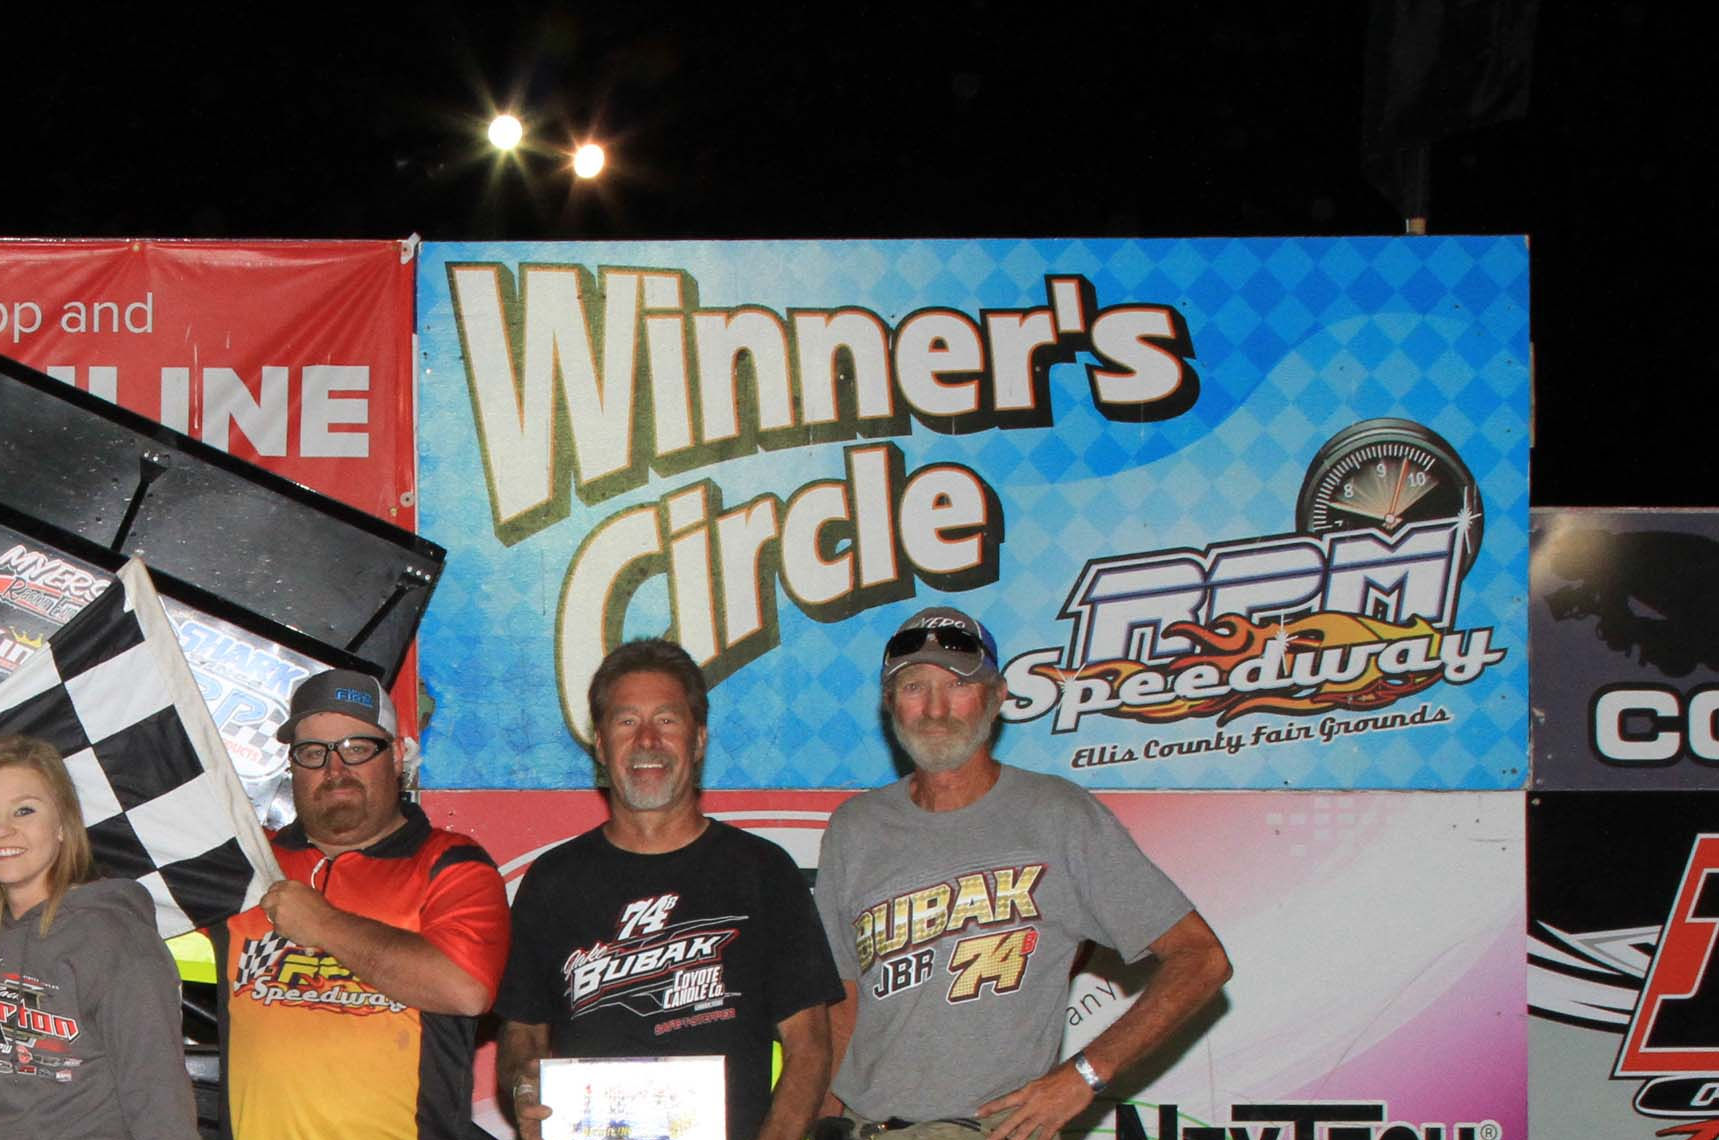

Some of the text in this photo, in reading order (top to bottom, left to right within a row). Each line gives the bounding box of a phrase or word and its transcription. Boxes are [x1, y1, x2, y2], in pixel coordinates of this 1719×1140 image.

[59, 292, 153, 334] and
[447, 262, 1198, 543] Winner's
[1343, 483, 1354, 498] 8
[1376, 463, 1386, 478] 9
[1407, 471, 1427, 487] 10
[555, 442, 1004, 746] Circle
[1070, 518, 1466, 666] RPM
[1002, 624, 1504, 734] Speedway
[1071, 702, 1451, 769] Ellis County Fair Grounds
[853, 863, 1048, 976] BUBAK
[573, 935, 723, 1003] BUBAK
[663, 986, 707, 1010] CANDLE
[674, 966, 722, 992] COYOTE
[873, 945, 935, 1000] JBR
